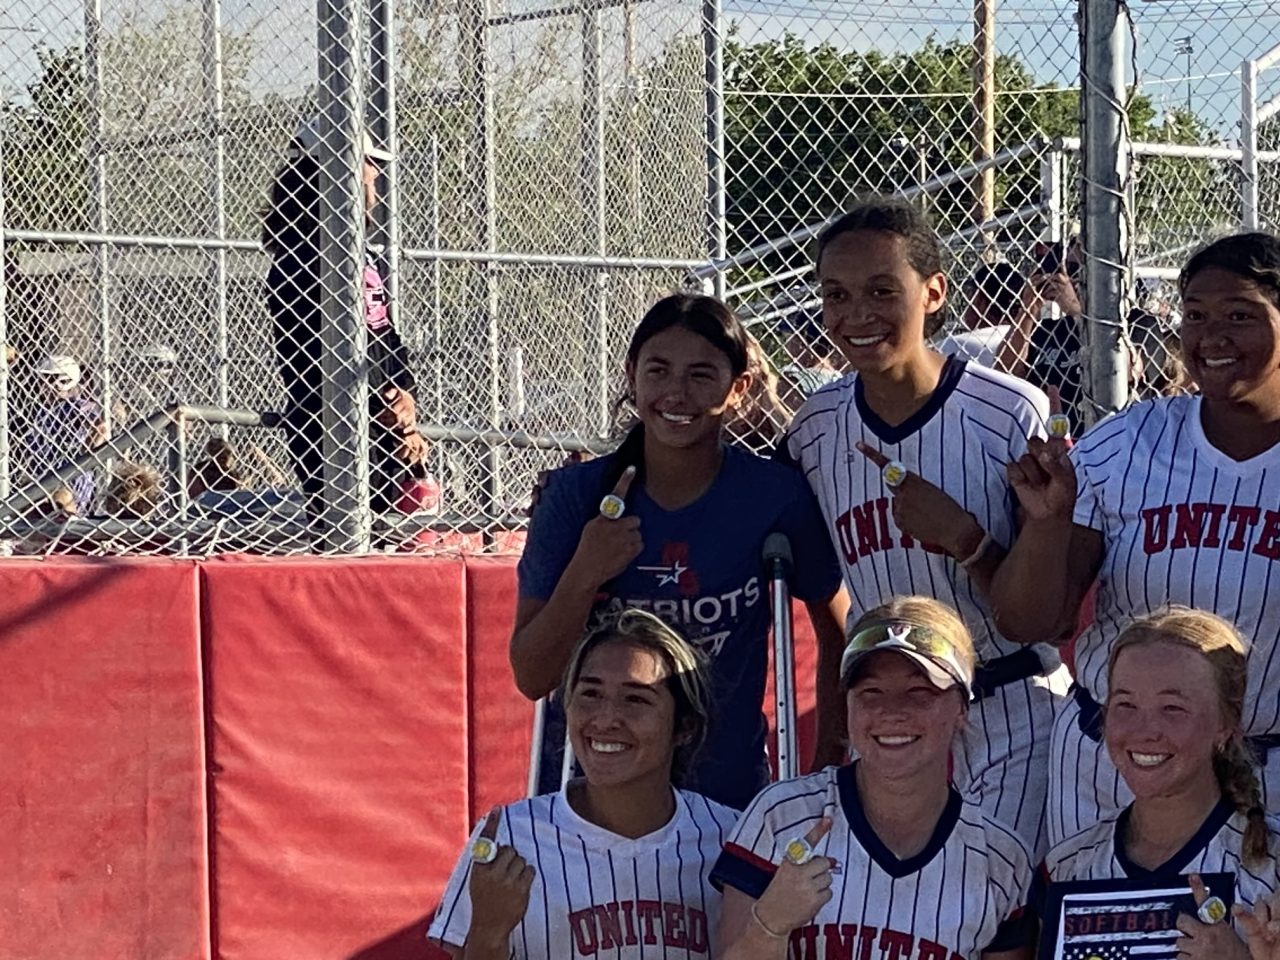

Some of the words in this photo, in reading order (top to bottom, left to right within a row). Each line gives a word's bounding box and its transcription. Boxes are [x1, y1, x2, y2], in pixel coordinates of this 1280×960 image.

[835, 497, 956, 566] UNI
[568, 900, 708, 956] UNITED
[1065, 911, 1171, 934] SOFTBAL
